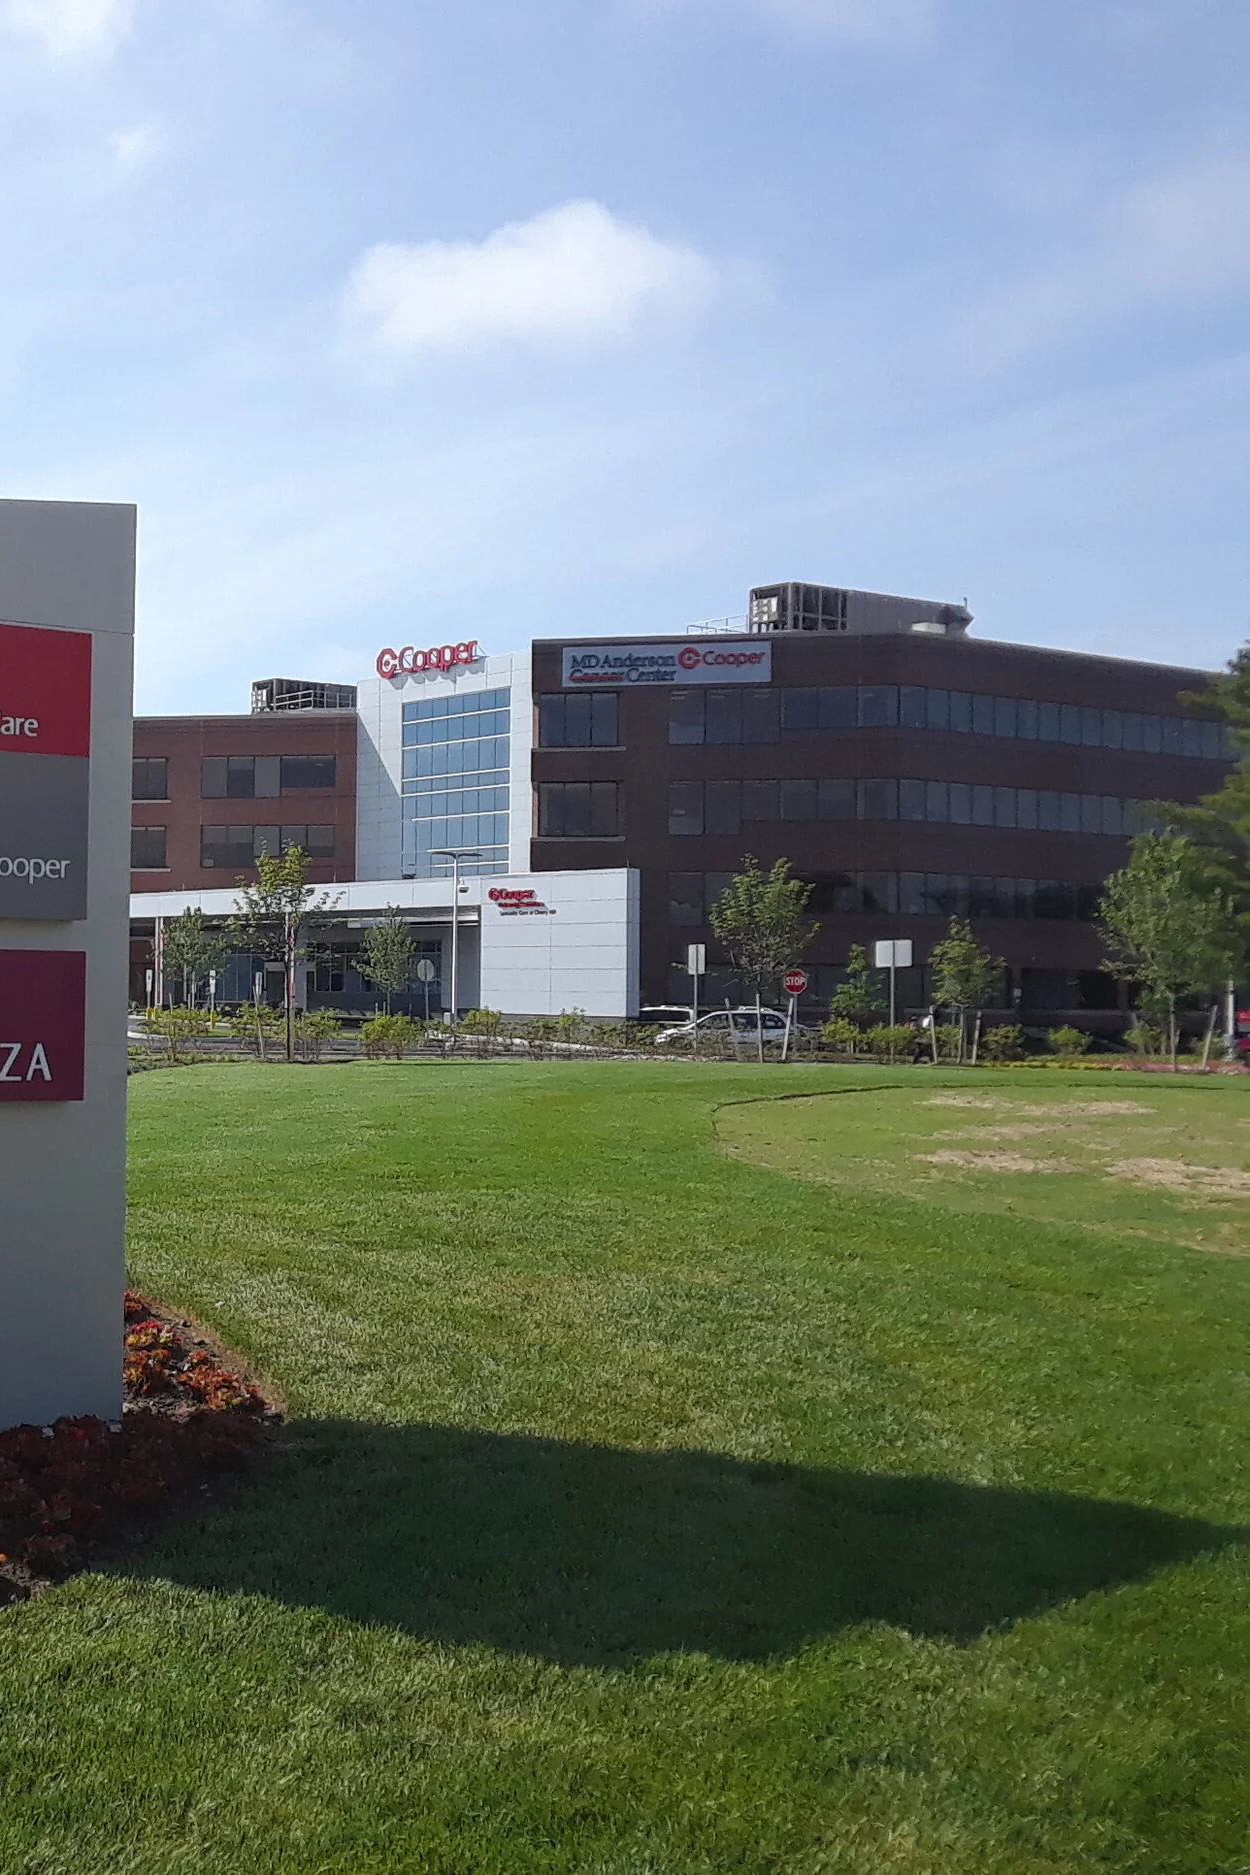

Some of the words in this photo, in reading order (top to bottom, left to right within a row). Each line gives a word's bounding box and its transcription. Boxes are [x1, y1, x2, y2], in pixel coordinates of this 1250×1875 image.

[398, 640, 479, 673] Cooper
[570, 655, 600, 670] MD
[601, 653, 676, 668] Anderson
[703, 651, 766, 668] Cooper
[626, 667, 677, 683] Center
[785, 976, 806, 986] STOP
